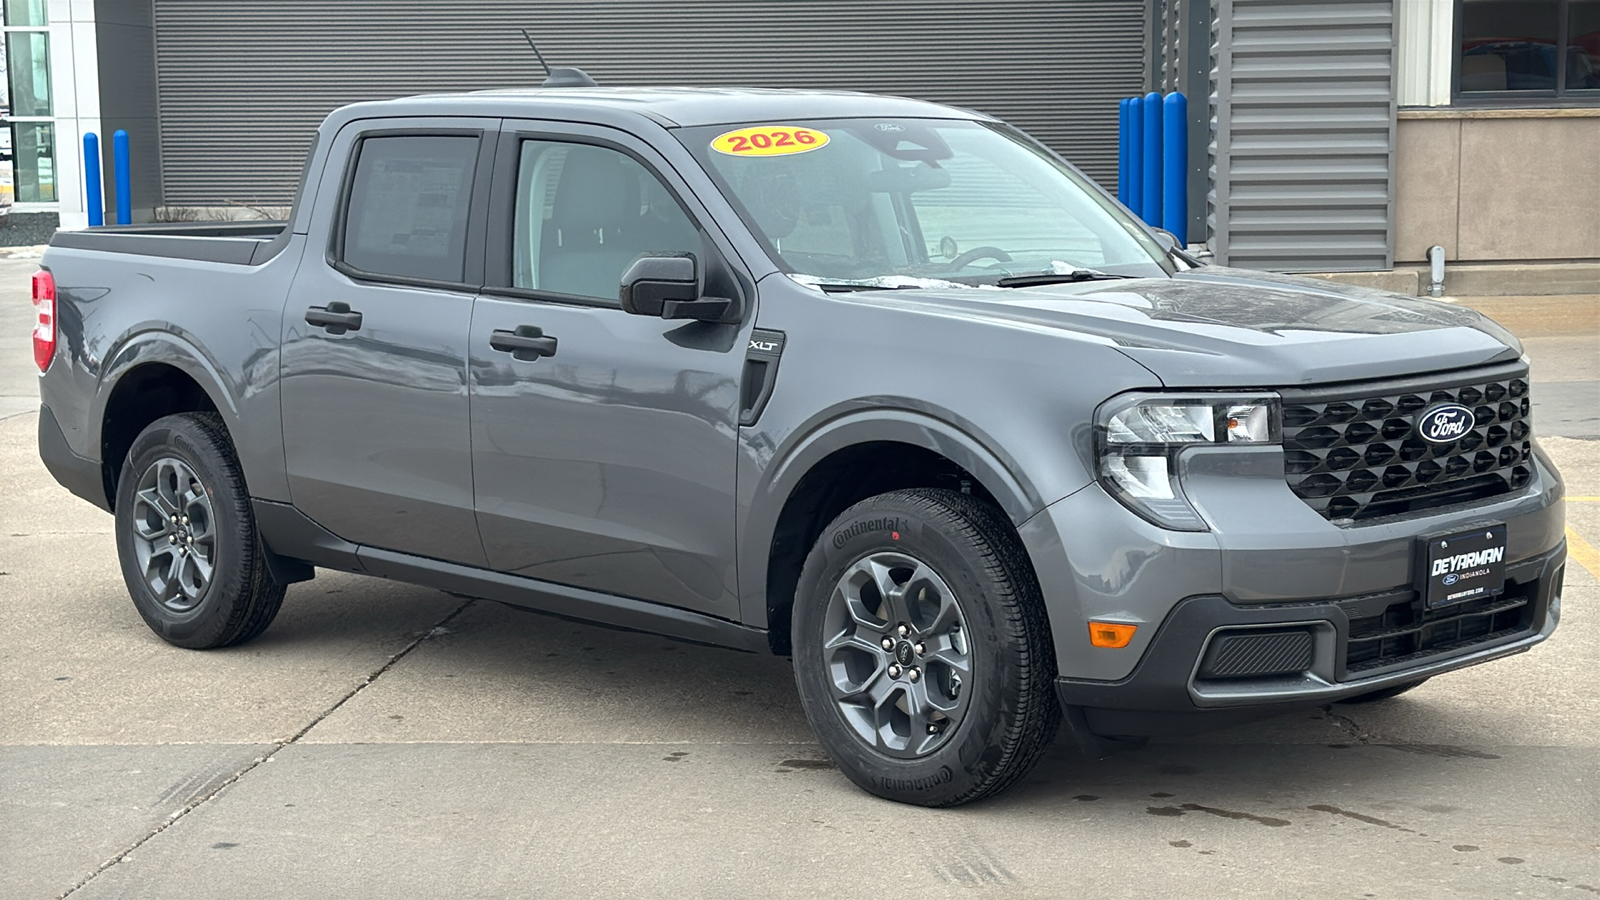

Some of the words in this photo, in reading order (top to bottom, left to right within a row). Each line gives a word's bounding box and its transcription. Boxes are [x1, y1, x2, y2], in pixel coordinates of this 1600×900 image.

[727, 130, 817, 152] 2026
[748, 340, 778, 351] XLT
[1430, 410, 1466, 438] Ford
[832, 516, 900, 549] Continental
[1431, 546, 1504, 577] DEYARMAN
[1460, 568, 1490, 580] INDIANOLA
